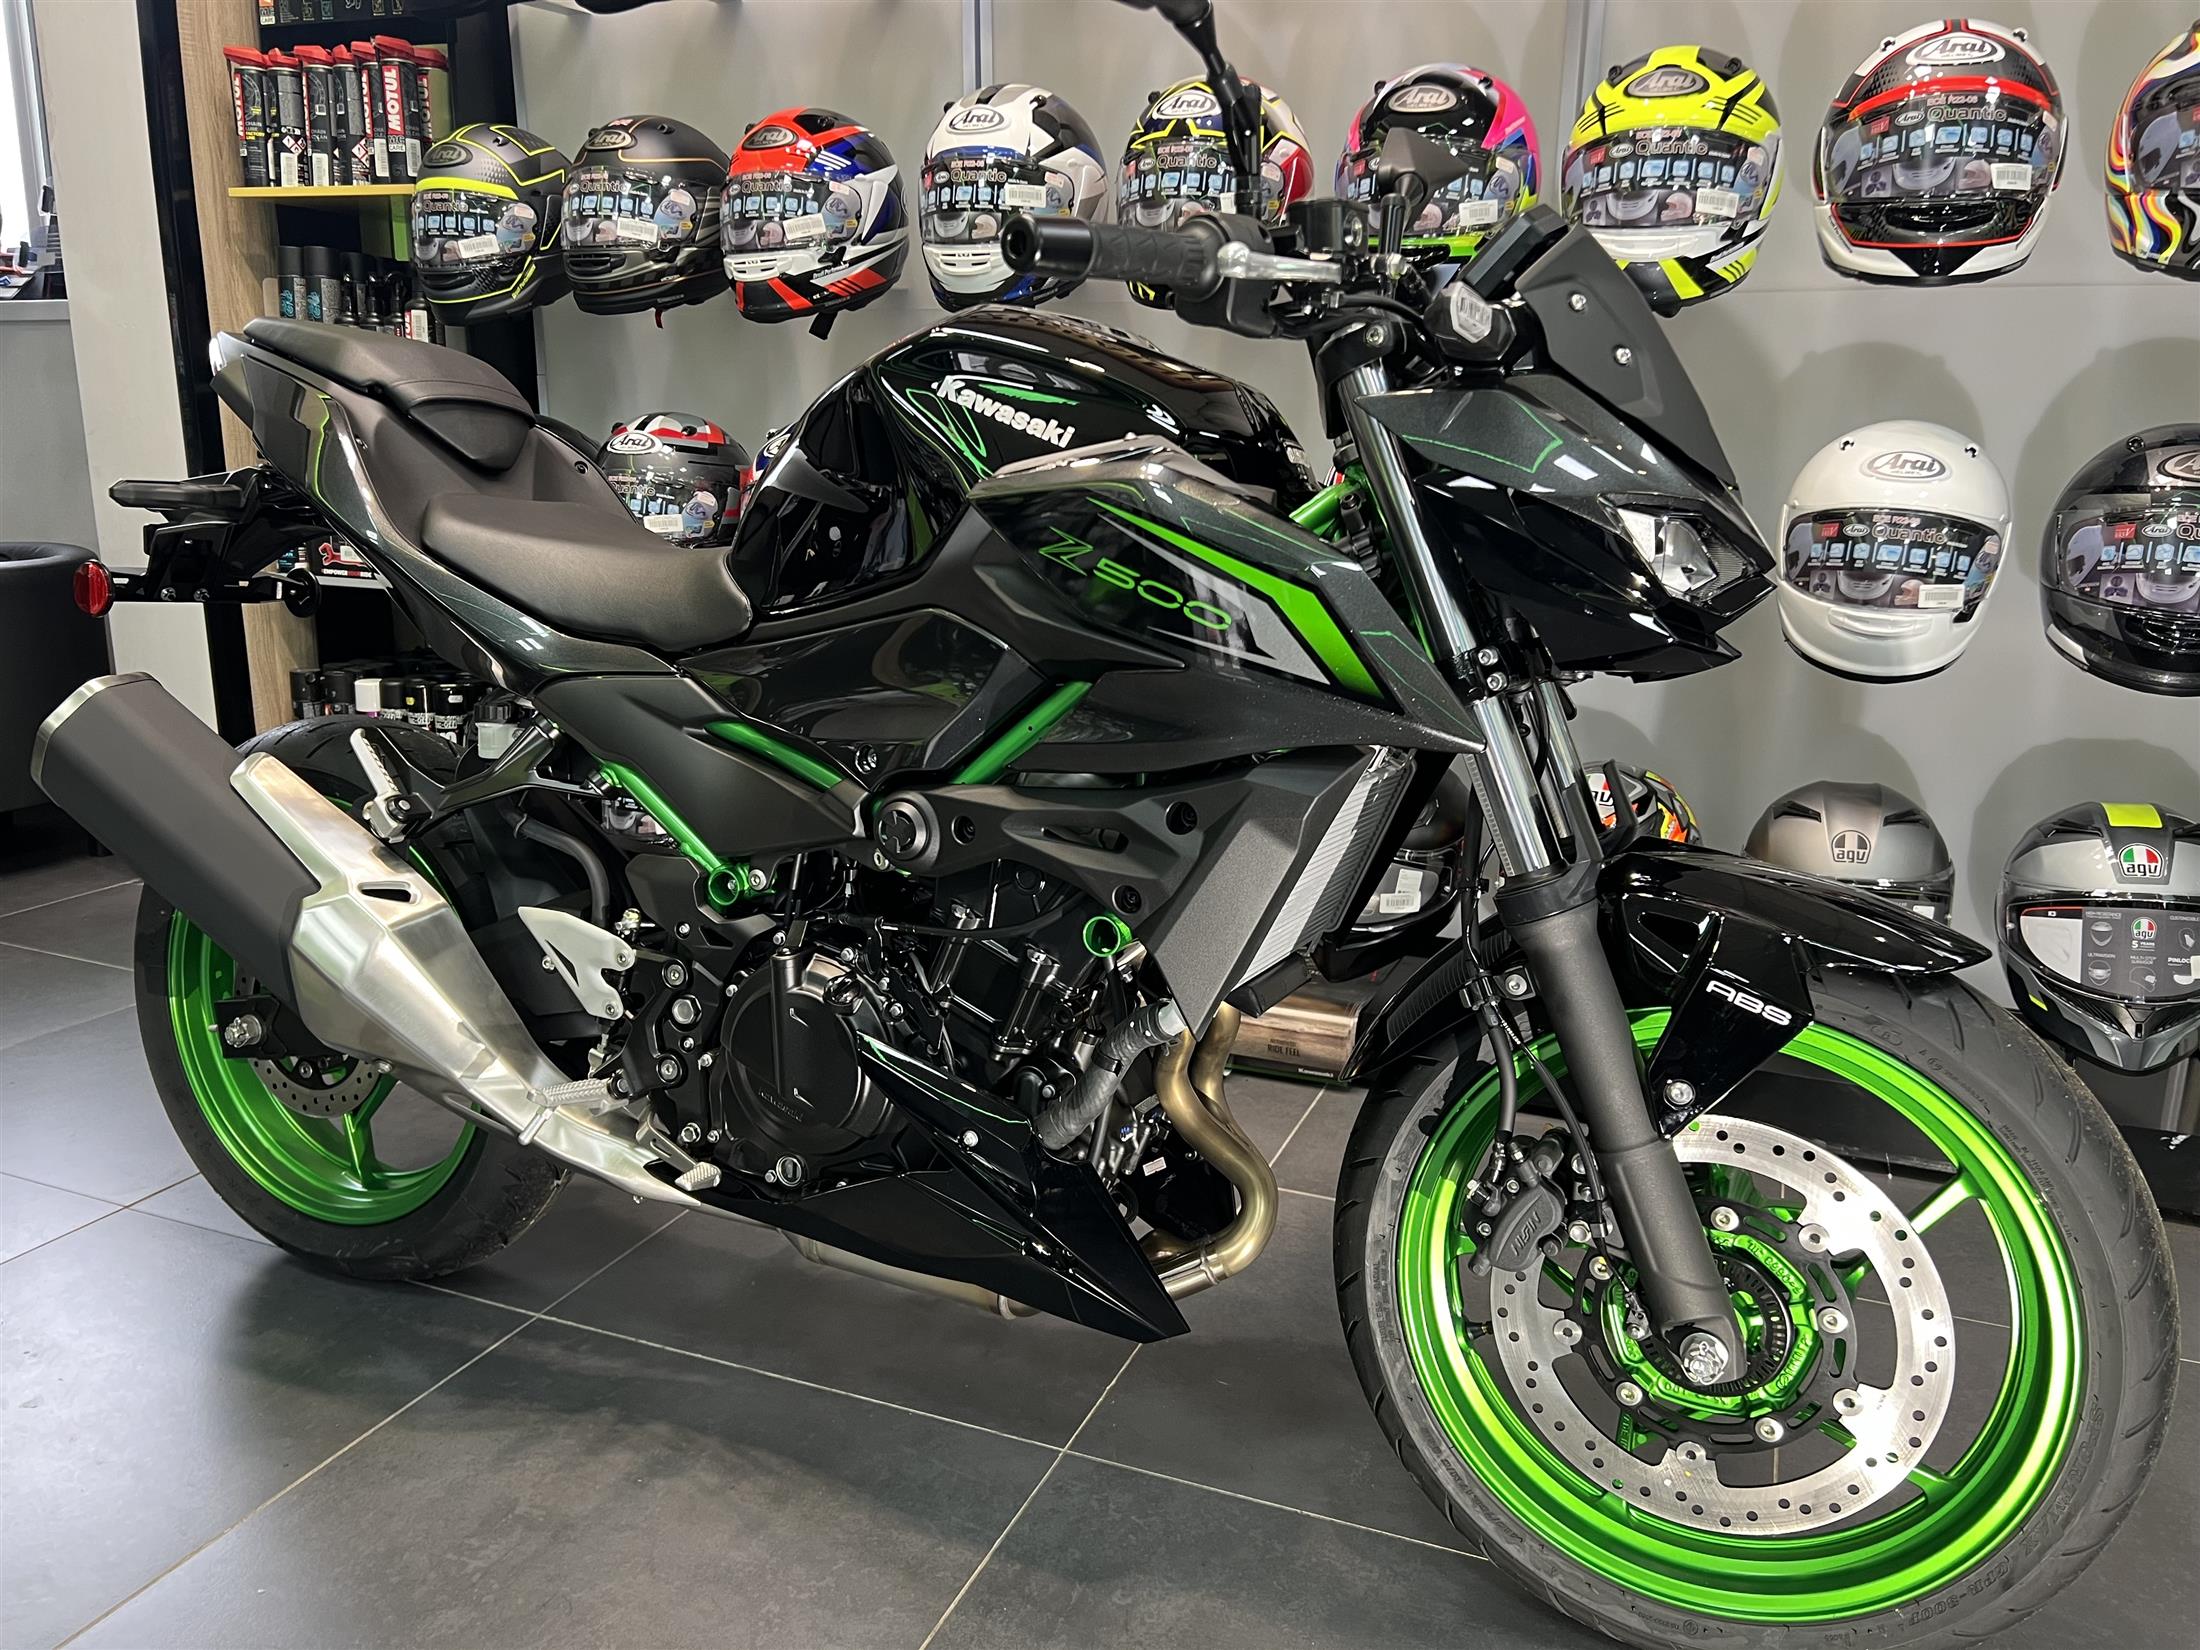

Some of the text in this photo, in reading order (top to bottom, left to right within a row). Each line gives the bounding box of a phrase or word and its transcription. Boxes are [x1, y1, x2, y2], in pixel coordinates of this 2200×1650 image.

[1922, 39, 1988, 57] Arai
[384, 69, 401, 131] MOTUL
[1402, 88, 1449, 105] Arai
[951, 112, 997, 127] Arai
[1928, 107, 2007, 122] Quantic
[951, 168, 1007, 182] Quantic
[931, 375, 1076, 448] Kawasaki
[1872, 453, 1939, 473] Arai
[1872, 523, 1948, 545] Quantic
[1836, 849, 1867, 864] agv
[2127, 863, 2158, 877] agv
[2135, 931, 2153, 939] agv
[2131, 940, 2139, 948] 5
[1706, 980, 1792, 1026] ABS
[1511, 1211, 1541, 1256] NISSIN
